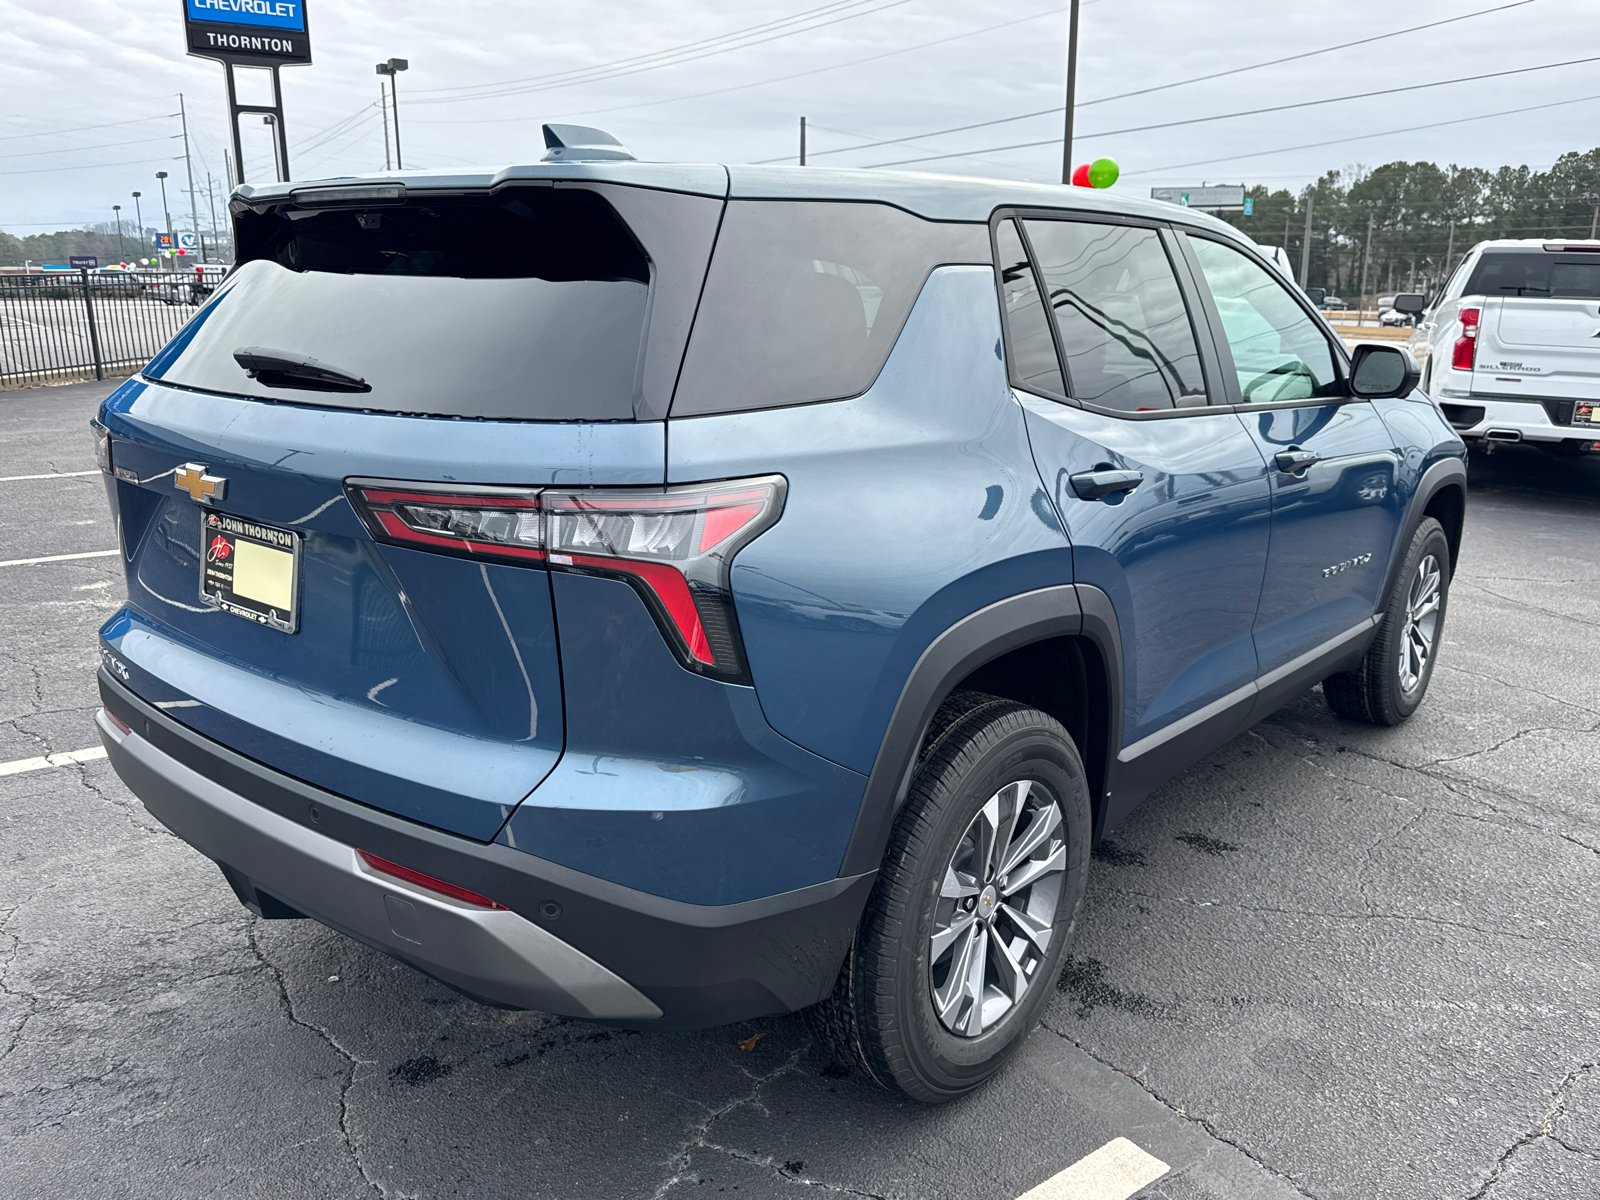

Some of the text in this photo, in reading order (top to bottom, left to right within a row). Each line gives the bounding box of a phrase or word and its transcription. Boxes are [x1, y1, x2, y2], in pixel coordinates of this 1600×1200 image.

[194, 0, 296, 17] CHEVROLET
[207, 33, 293, 53] THORNTON
[222, 518, 291, 546] JOHN THORNTON
[230, 606, 257, 621] CHEVROLET
